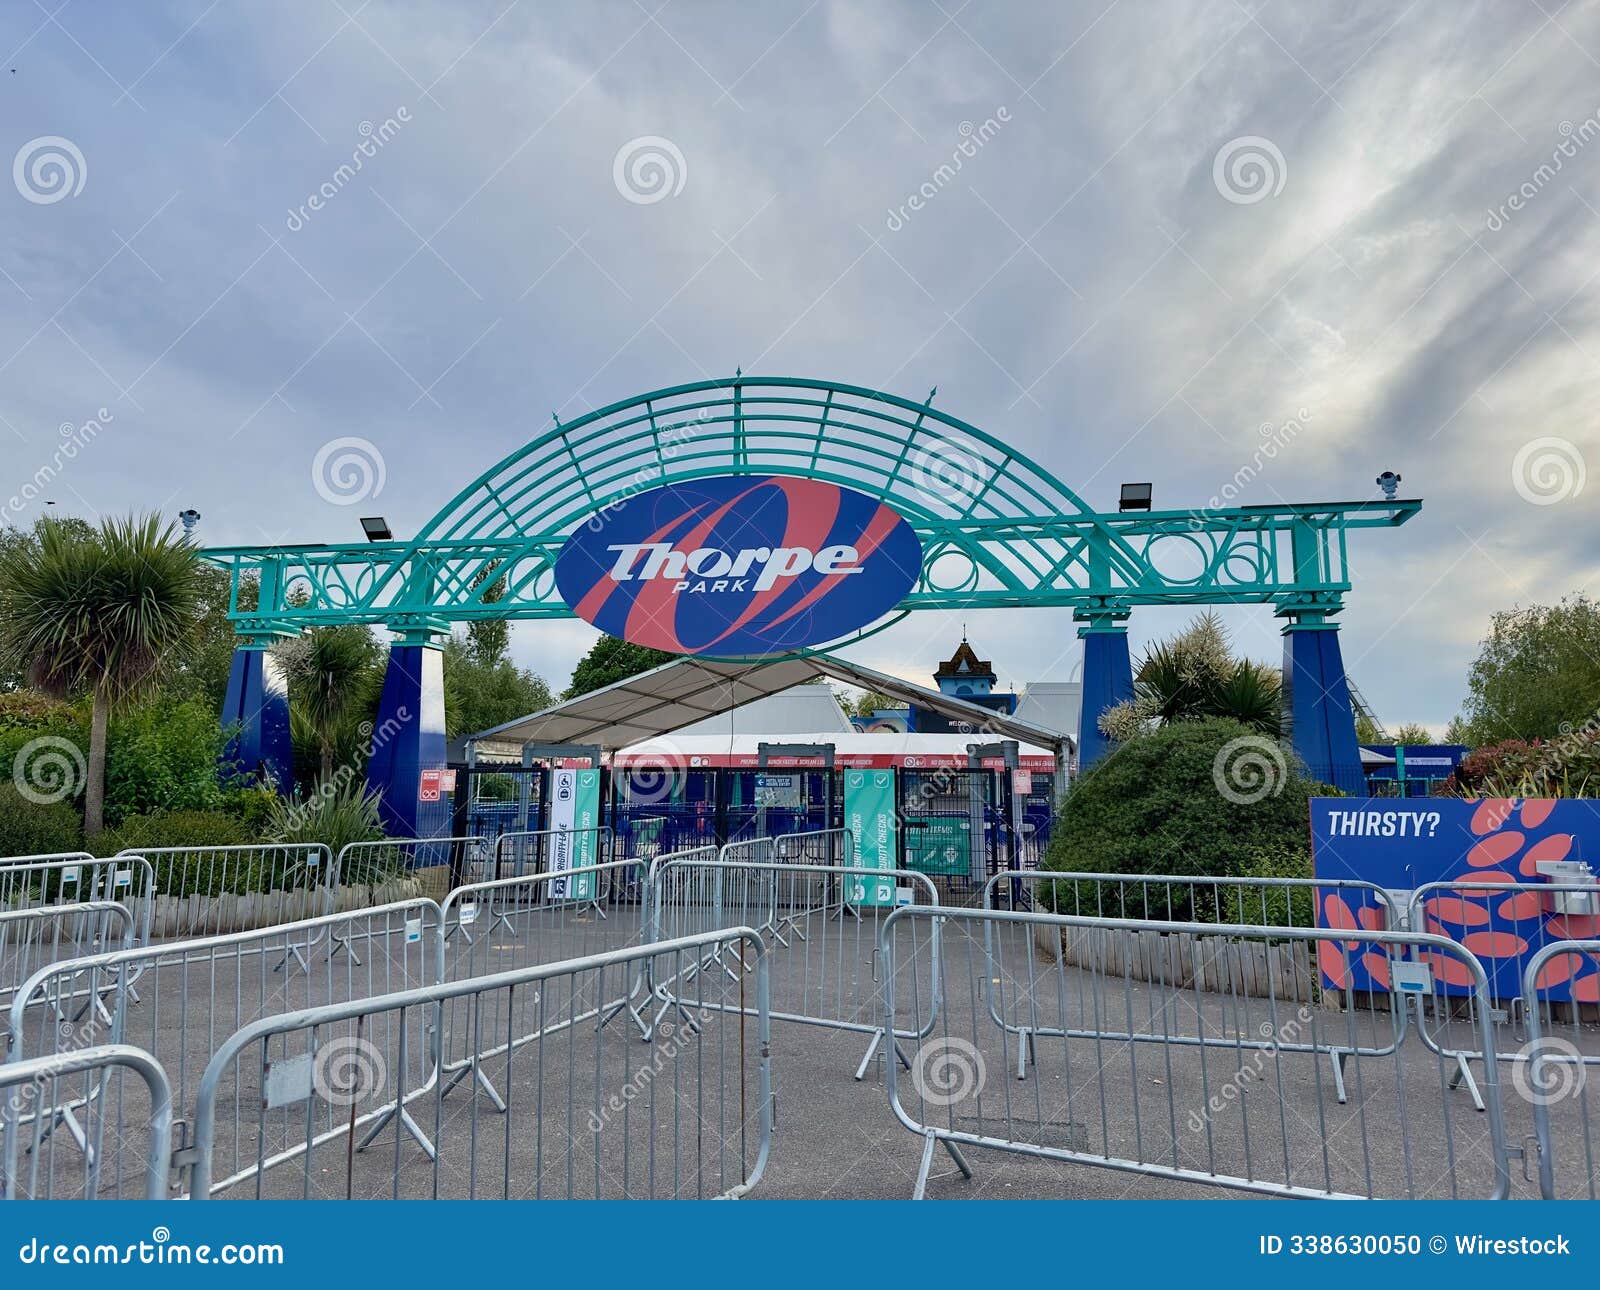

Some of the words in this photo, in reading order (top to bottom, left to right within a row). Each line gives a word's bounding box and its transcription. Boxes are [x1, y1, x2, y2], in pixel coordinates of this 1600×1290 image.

[606, 542, 865, 592] Thorpe
[671, 579, 749, 594] PARK
[852, 813, 861, 843] CHECKS
[877, 813, 887, 843] CHECKS
[1328, 811, 1441, 838] THIRSTY?
[557, 841, 568, 872] RIORITY
[852, 844, 862, 880] SURITY
[878, 843, 888, 881] SCURITY
